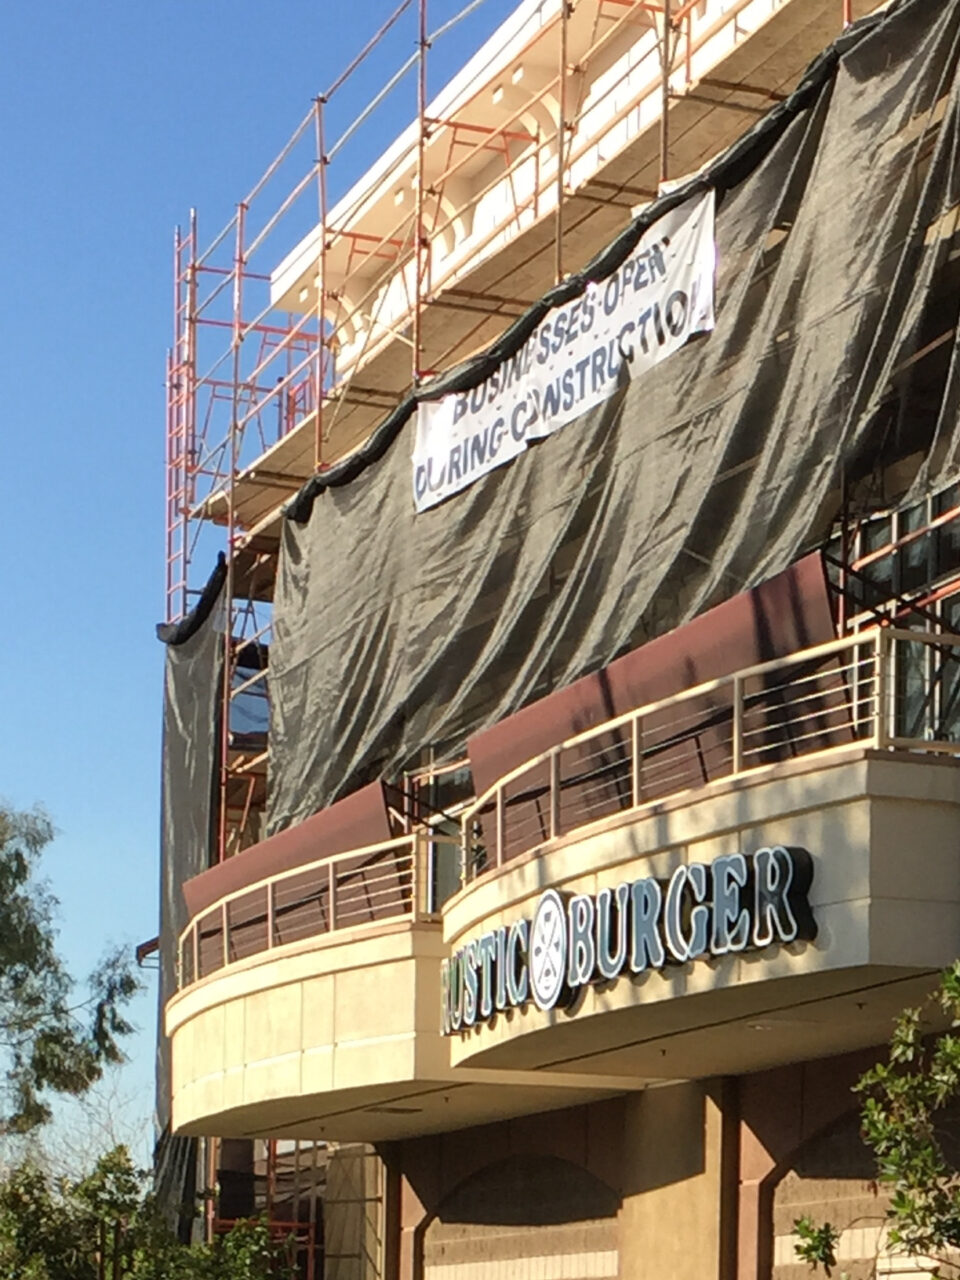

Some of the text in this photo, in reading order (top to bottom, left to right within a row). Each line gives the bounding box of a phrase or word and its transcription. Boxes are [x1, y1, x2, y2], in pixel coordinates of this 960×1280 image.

[604, 236, 670, 317] OPEN
[415, 417, 505, 500] DURING
[567, 846, 799, 988] BURGER
